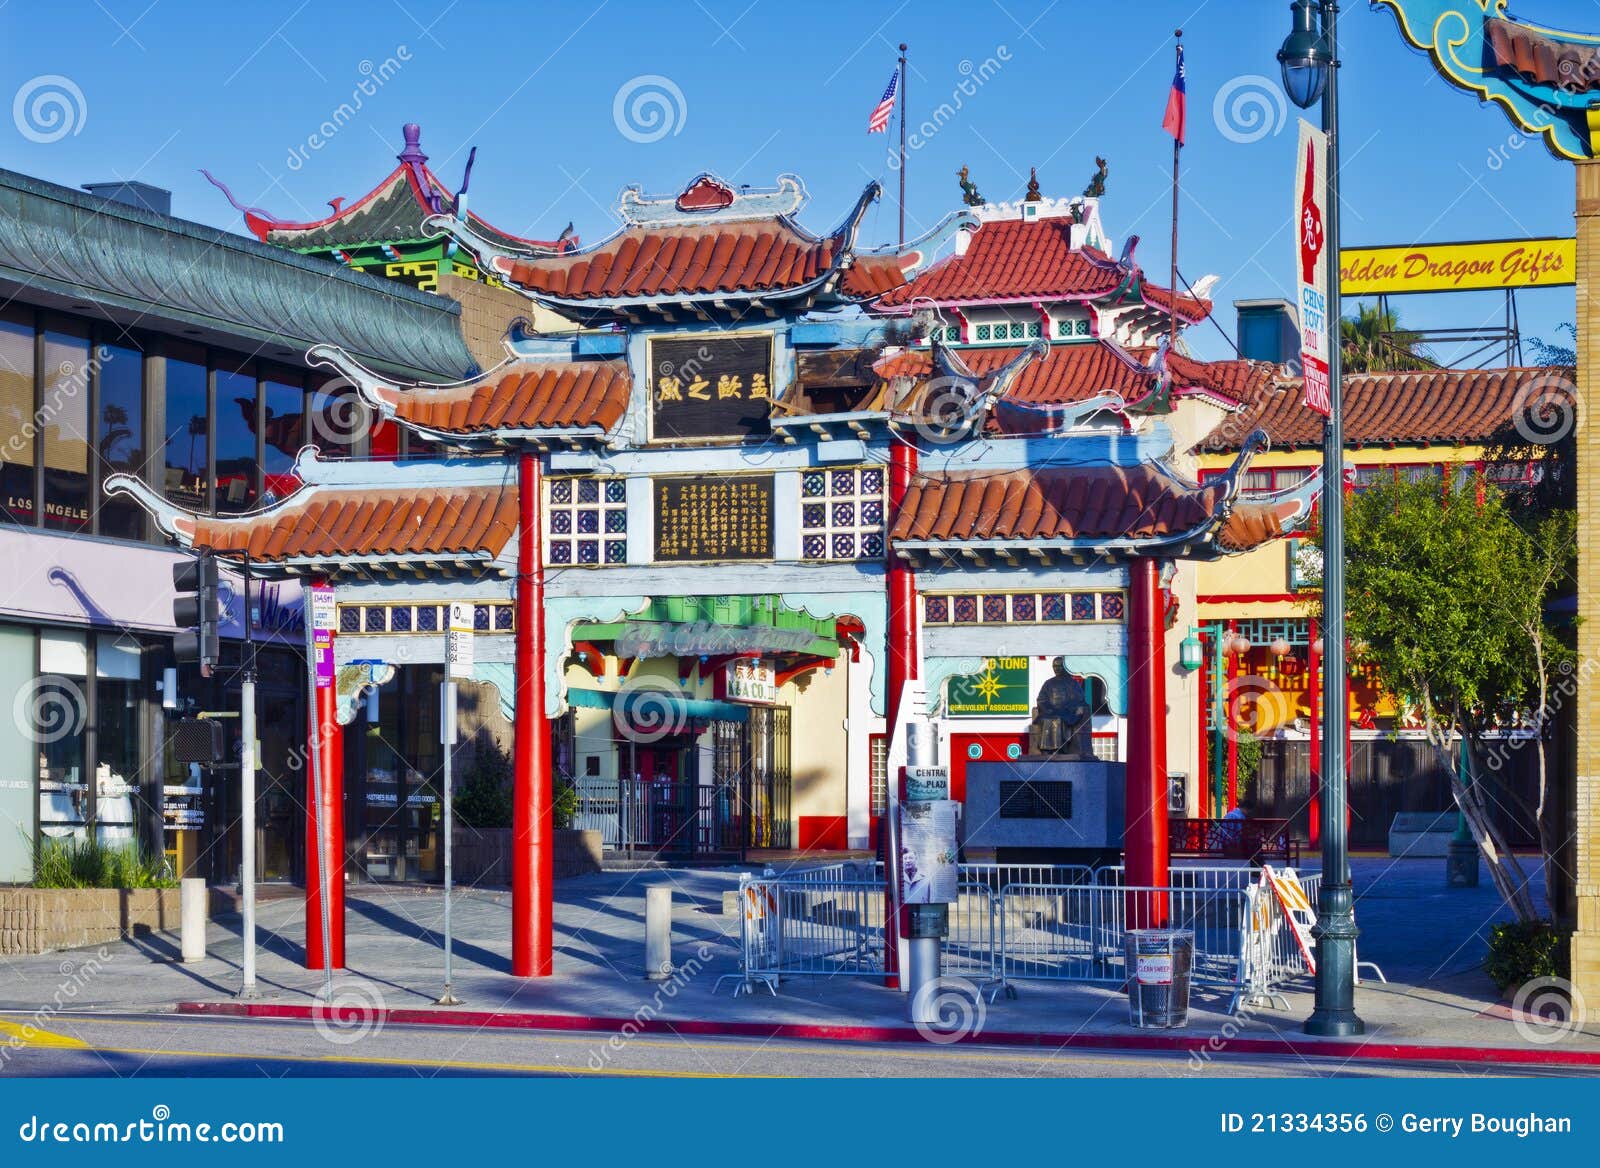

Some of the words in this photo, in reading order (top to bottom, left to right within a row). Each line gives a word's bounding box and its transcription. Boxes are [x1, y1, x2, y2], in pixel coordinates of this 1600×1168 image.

[1303, 207, 1317, 251] 兔
[1340, 257, 1398, 282] olden
[1403, 253, 1494, 285] Dragon
[1500, 247, 1564, 284] Gifts
[1305, 376, 1329, 413] NEWS
[8, 496, 33, 510] LOS
[43, 503, 89, 520] NGELE
[449, 632, 458, 641] 45
[450, 642, 458, 652] 83
[450, 653, 458, 663] 84
[999, 656, 1027, 670] TONG
[989, 704, 1028, 712] ASSOCIATION
[916, 769, 947, 777] CENTRAL
[926, 780, 947, 789] PLAZA
